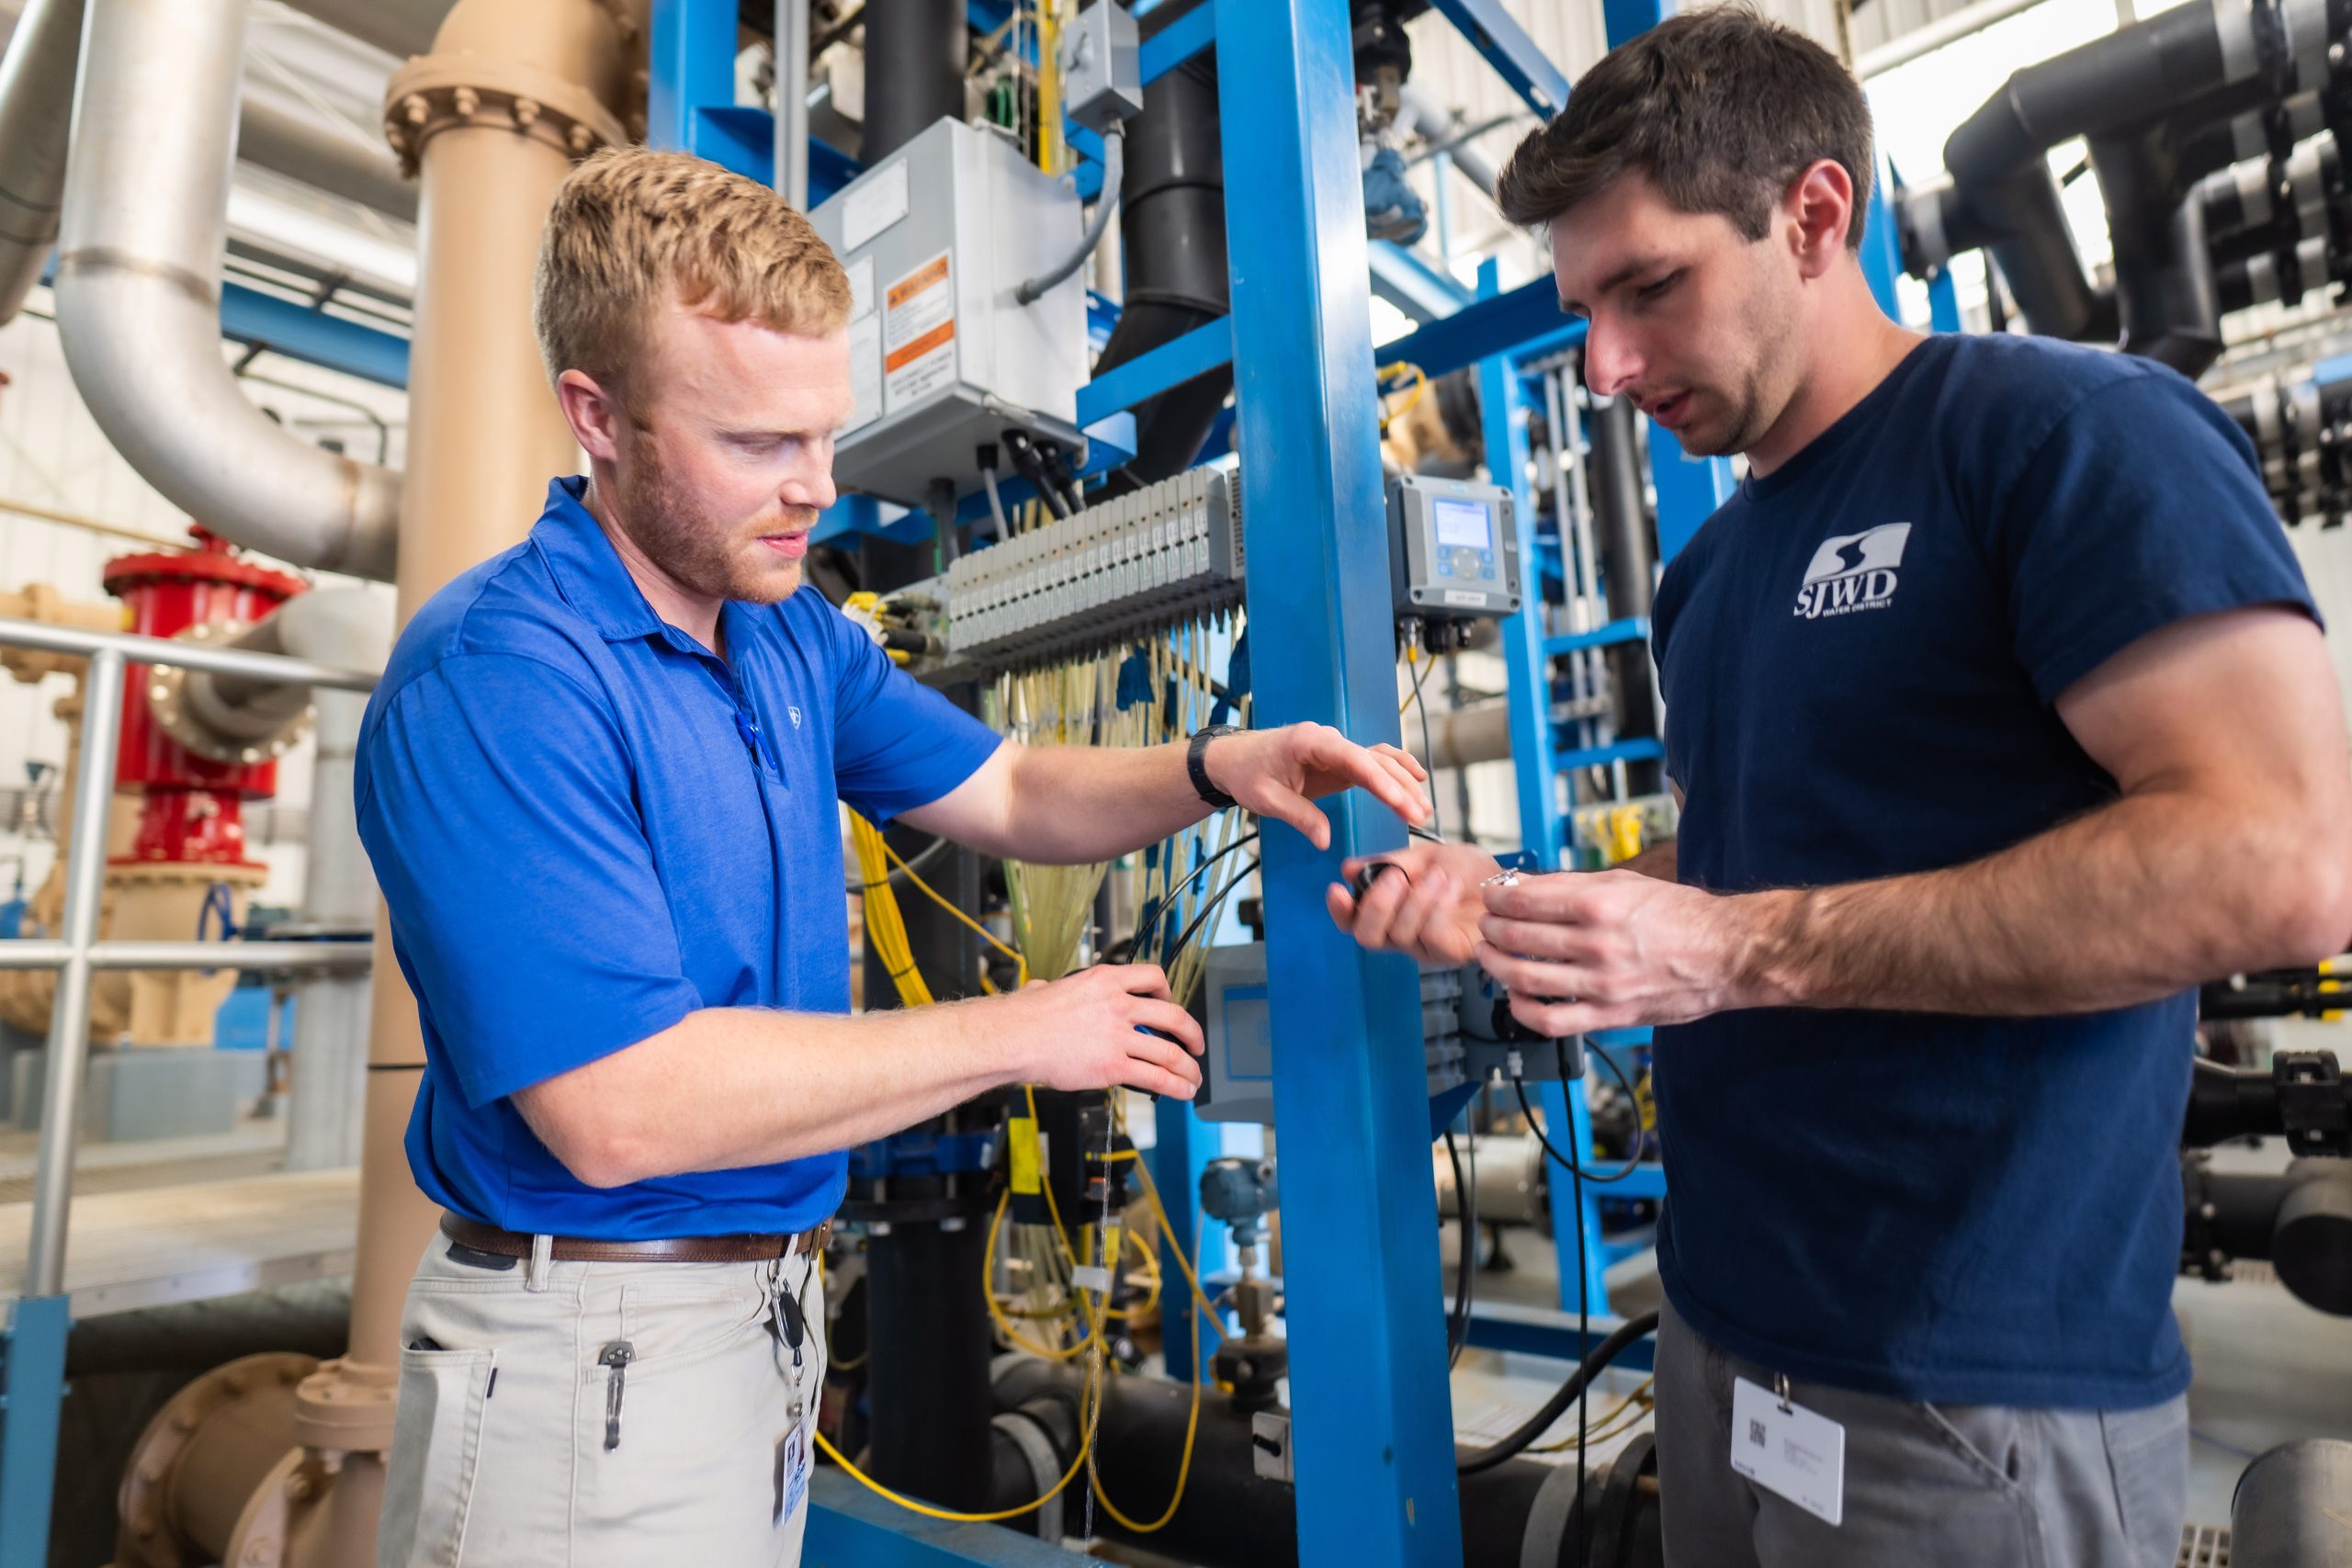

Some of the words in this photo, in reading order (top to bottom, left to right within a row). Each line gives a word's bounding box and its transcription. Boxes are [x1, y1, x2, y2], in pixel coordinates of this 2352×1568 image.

[1793, 569, 1897, 620] SJWD
[1822, 604, 1850, 617] WATER
[1851, 597, 1892, 613] DISTRICT
